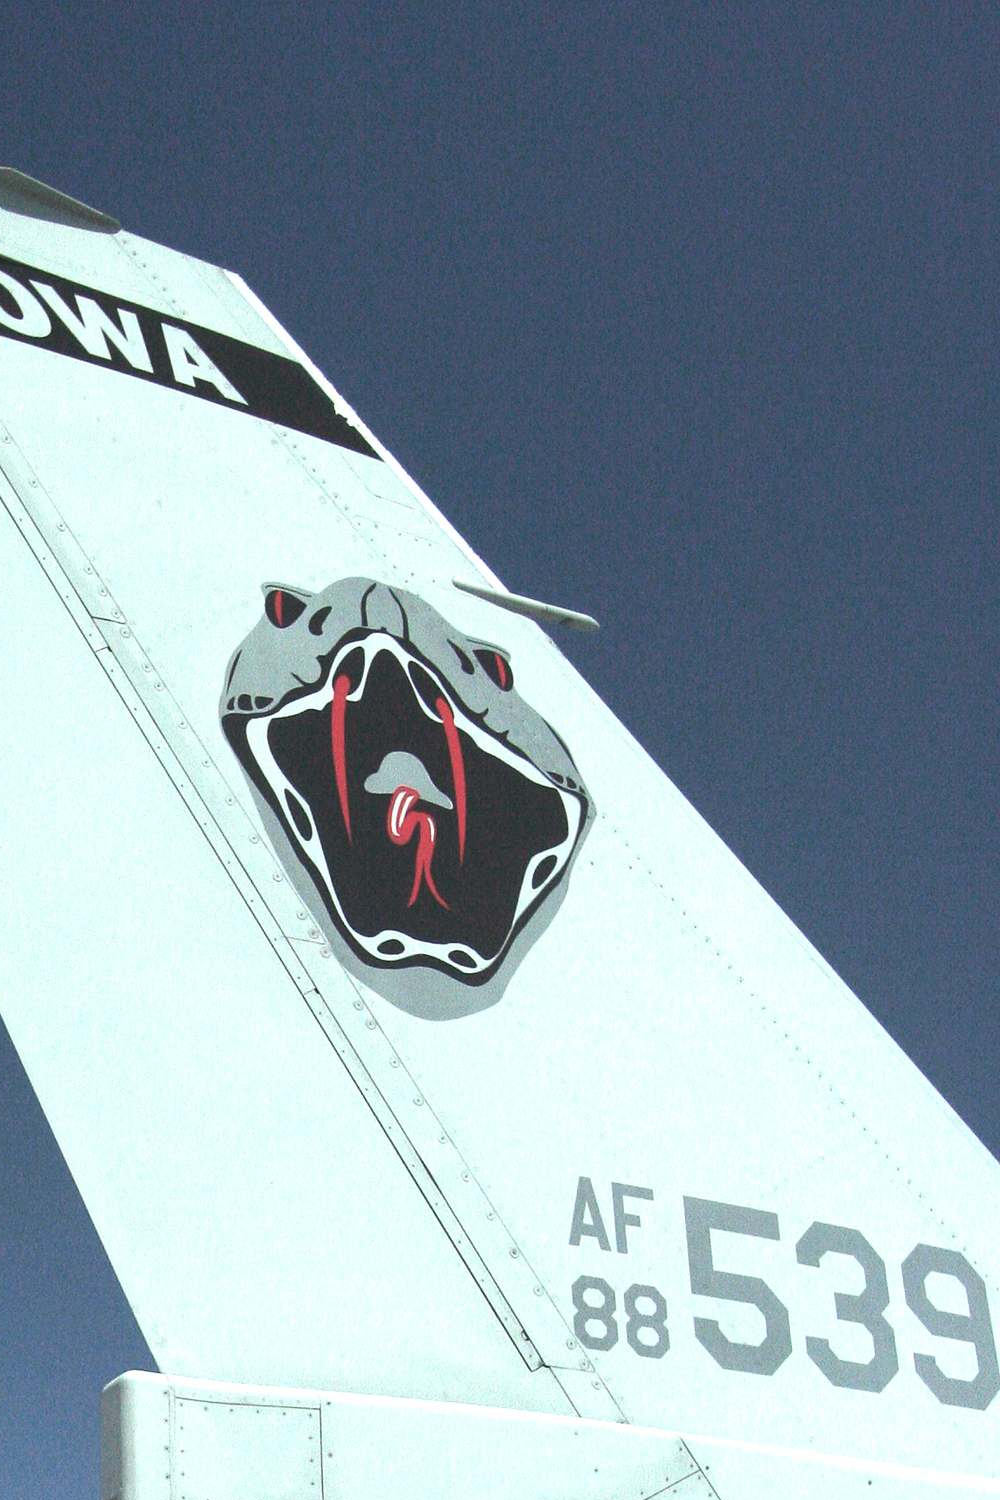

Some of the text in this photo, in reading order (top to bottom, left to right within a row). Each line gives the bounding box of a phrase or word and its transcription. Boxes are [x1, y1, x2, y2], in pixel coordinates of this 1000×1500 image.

[568, 1175, 654, 1255] AF
[571, 1274, 671, 1360] 88
[682, 1194, 1000, 1411] 539
